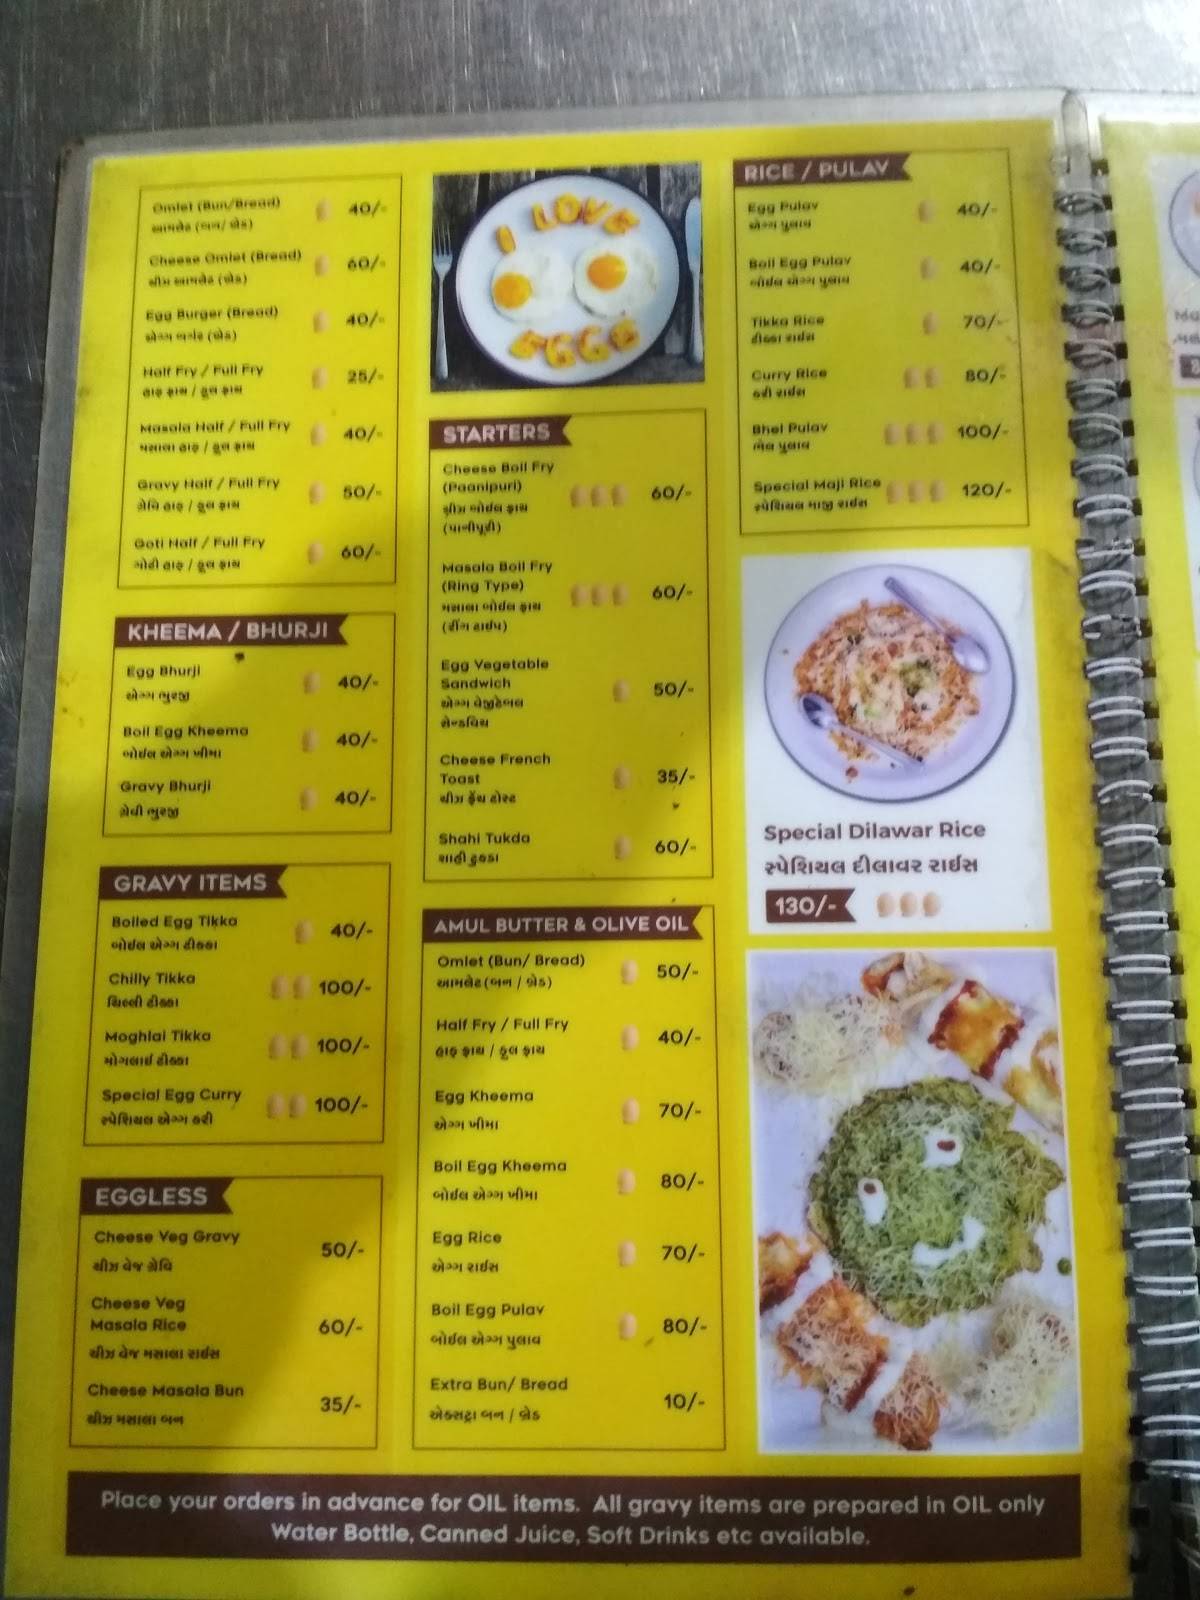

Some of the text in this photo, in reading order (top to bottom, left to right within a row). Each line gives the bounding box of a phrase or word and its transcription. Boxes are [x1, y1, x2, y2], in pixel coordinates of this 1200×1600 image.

[744, 163, 795, 183] RICE
[819, 159, 890, 180] PULAV
[443, 423, 550, 444] STARTERS
[128, 622, 222, 641] KHEEMA
[246, 622, 328, 639] BHURJI
[126, 665, 201, 681] Egg Bhurji
[441, 657, 549, 673] Egg Vegetable
[338, 674, 378, 691] 40/-
[441, 677, 511, 689] Sandwich
[654, 680, 694, 698] 50/-
[440, 753, 551, 766] Cheese French
[440, 773, 480, 785] Toast
[658, 767, 695, 785] 35/-
[439, 832, 530, 845] Shahi Tukda
[764, 820, 986, 845] Special Dilawar Rice
[655, 838, 696, 856] 60/-
[114, 873, 267, 893] GRAVY ITEMS
[775, 894, 836, 918] 130/-
[112, 915, 238, 931] Boiled Egg Tikka
[330, 921, 373, 940] 40/-
[434, 915, 689, 934] AMUL BUTTER & OLIVE OIL
[437, 955, 483, 968] Omlet
[109, 972, 196, 987] Chilly Tikka
[657, 962, 699, 981] 50/-
[319, 978, 371, 997] 100/-
[436, 1018, 468, 1031] Half
[472, 1018, 496, 1033] Fry
[513, 1017, 540, 1030] Full
[545, 1018, 569, 1033] Fry
[105, 1029, 211, 1046] Moghlai Tikka
[317, 1036, 370, 1055] 100/-
[658, 1027, 701, 1047] 40/-
[102, 1088, 242, 1105] Special Egg Curry
[315, 1095, 368, 1115] 100/-
[435, 1090, 534, 1105] Egg Kheema
[659, 1101, 701, 1121] 70/-
[434, 1159, 567, 1176] Boil Egg Kheema
[660, 1172, 704, 1191] 80/-
[95, 1186, 208, 1207] EGGLESS
[94, 1230, 240, 1246] Cheese Veg Gravy
[432, 1230, 502, 1247] Egg Rice
[321, 1240, 364, 1259] 50/-
[662, 1243, 705, 1263] 70/-
[91, 1296, 186, 1313] Cheese Veg
[431, 1303, 545, 1320] Boil Egg Pulav
[90, 1318, 187, 1332] Masala Rice
[318, 1317, 362, 1337] 60/-
[663, 1317, 707, 1336] 80/-
[87, 1383, 244, 1398] Cheese Masala Bun
[430, 1377, 473, 1391] Extra
[320, 1395, 361, 1415] 35/-
[664, 1391, 705, 1412] 10/-
[101, 1490, 1045, 1518] Place your orders in advance for OIL items. All gravy items are prepared in OIL only
[270, 1522, 870, 1545] Water Bottle, Canned Juice, Soft Drinks etc available.
